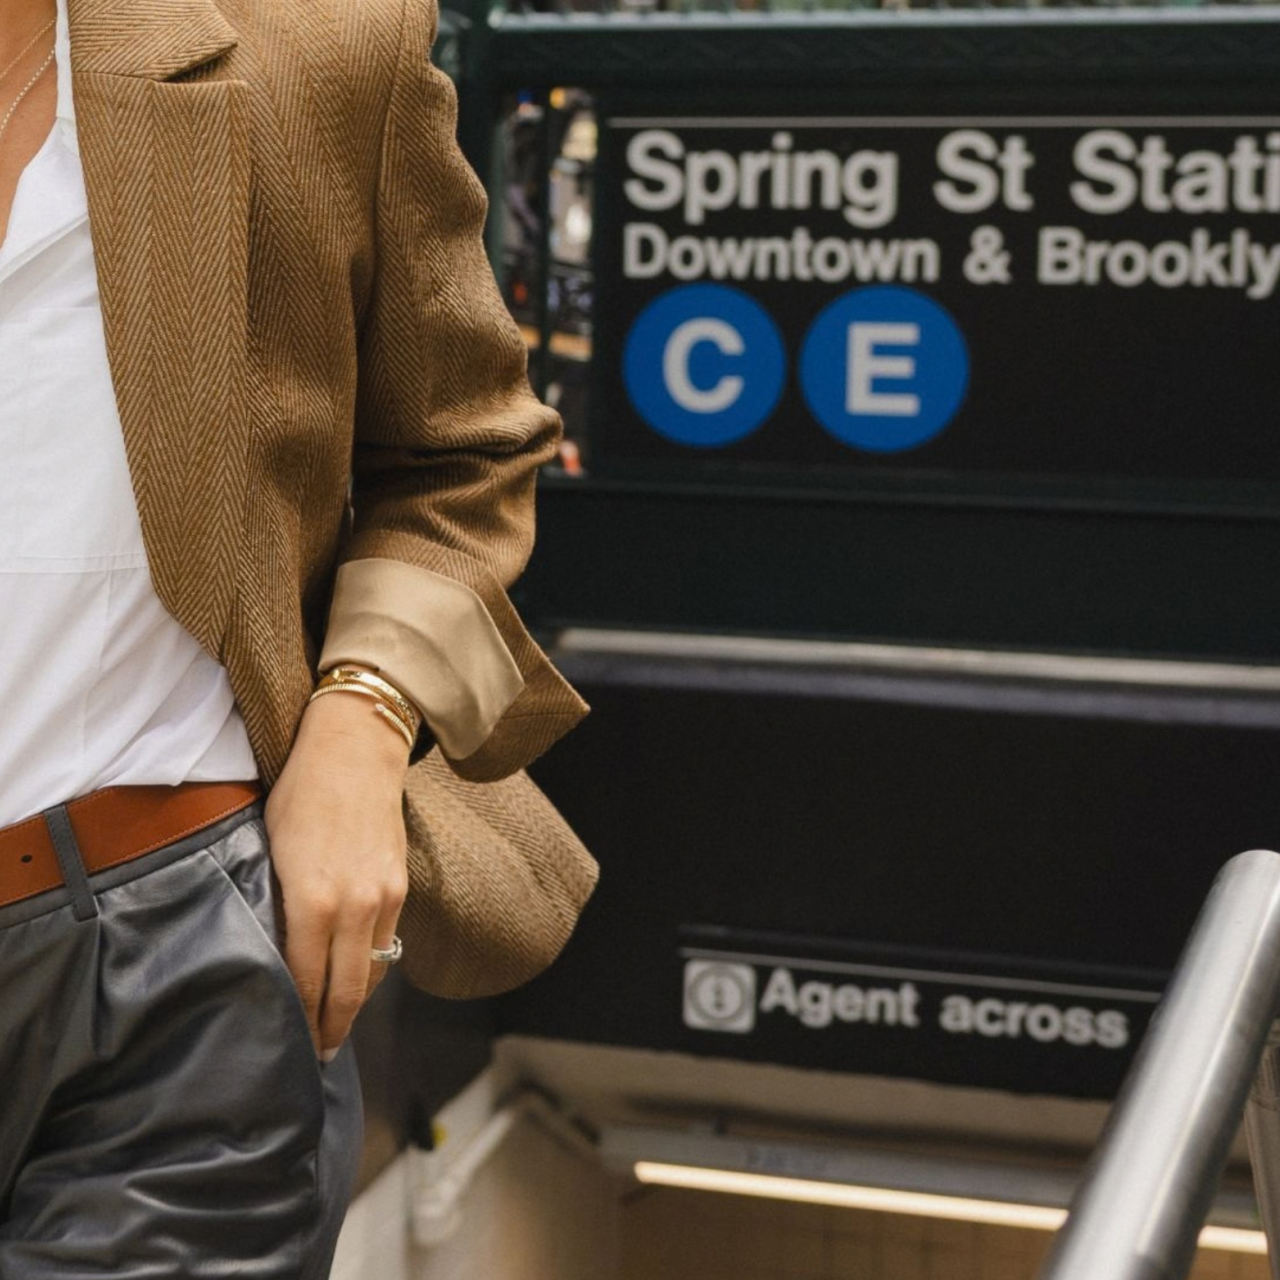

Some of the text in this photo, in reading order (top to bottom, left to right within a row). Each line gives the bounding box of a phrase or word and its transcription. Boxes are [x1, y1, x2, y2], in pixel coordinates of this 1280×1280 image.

[624, 129, 898, 229] Spring
[933, 129, 1034, 213] St
[624, 222, 1280, 299] Downtown & Brookly
[663, 318, 920, 416] C E
[760, 967, 1129, 1048] Agent across
